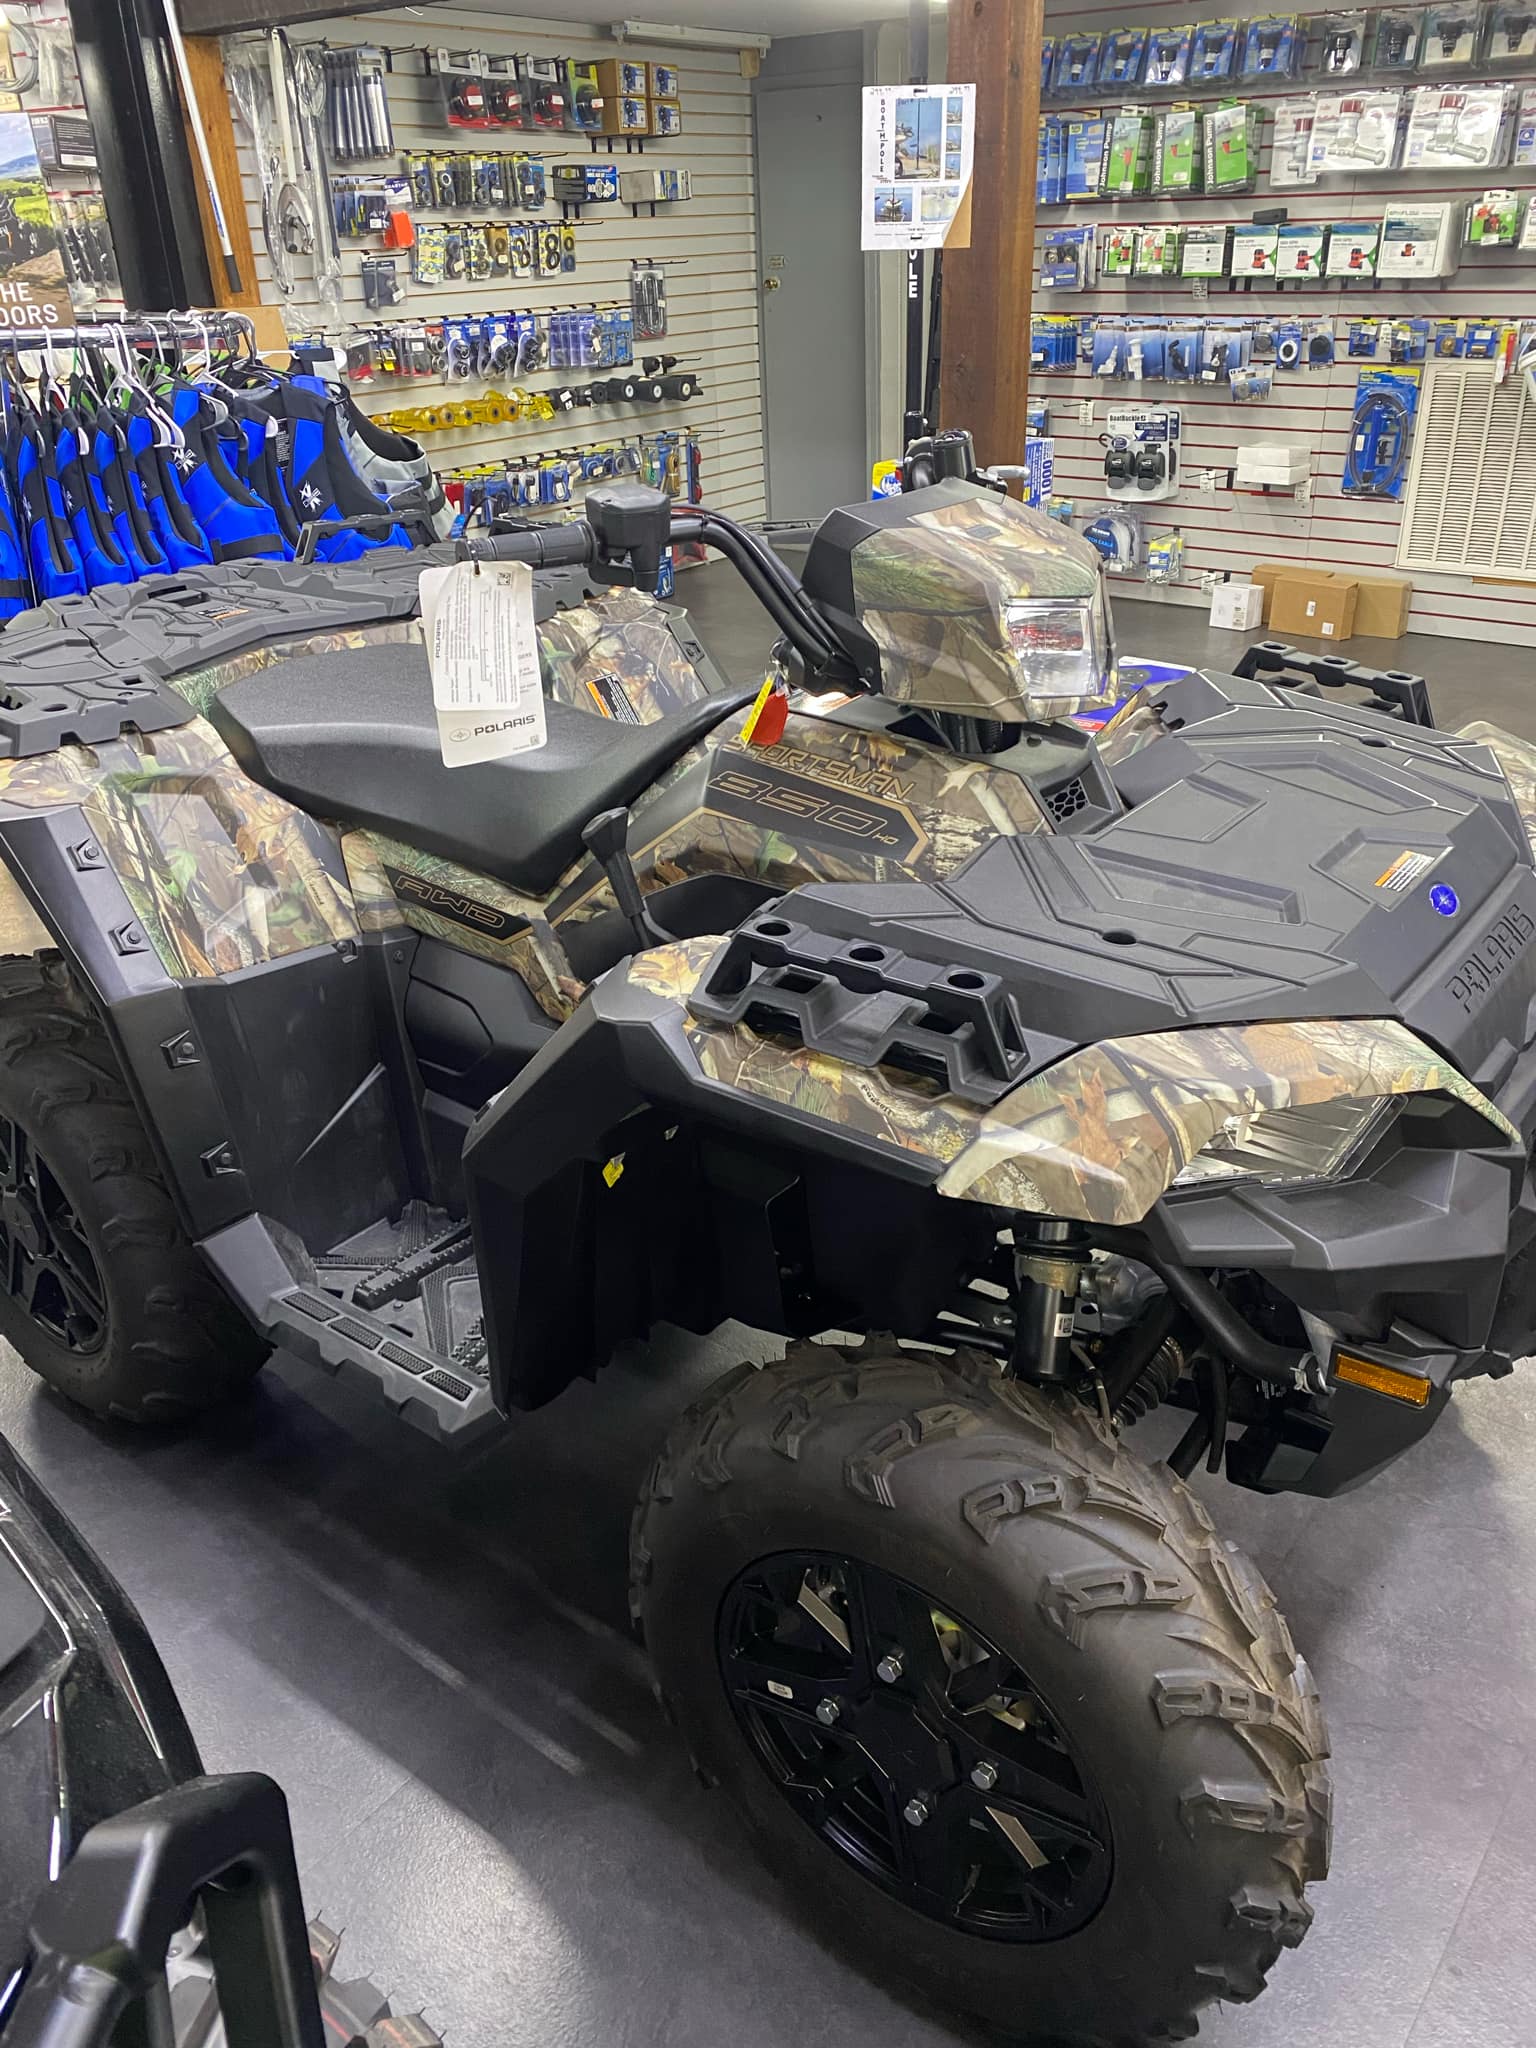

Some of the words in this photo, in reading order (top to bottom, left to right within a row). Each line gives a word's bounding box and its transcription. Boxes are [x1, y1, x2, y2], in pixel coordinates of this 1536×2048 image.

[1155, 120, 1165, 148] Pump
[1153, 148, 1162, 185] Johnson
[474, 714, 536, 737] POLARIS
[707, 770, 889, 838] 850
[396, 875, 505, 929] AWD
[1444, 903, 1536, 1014] POLARIS
